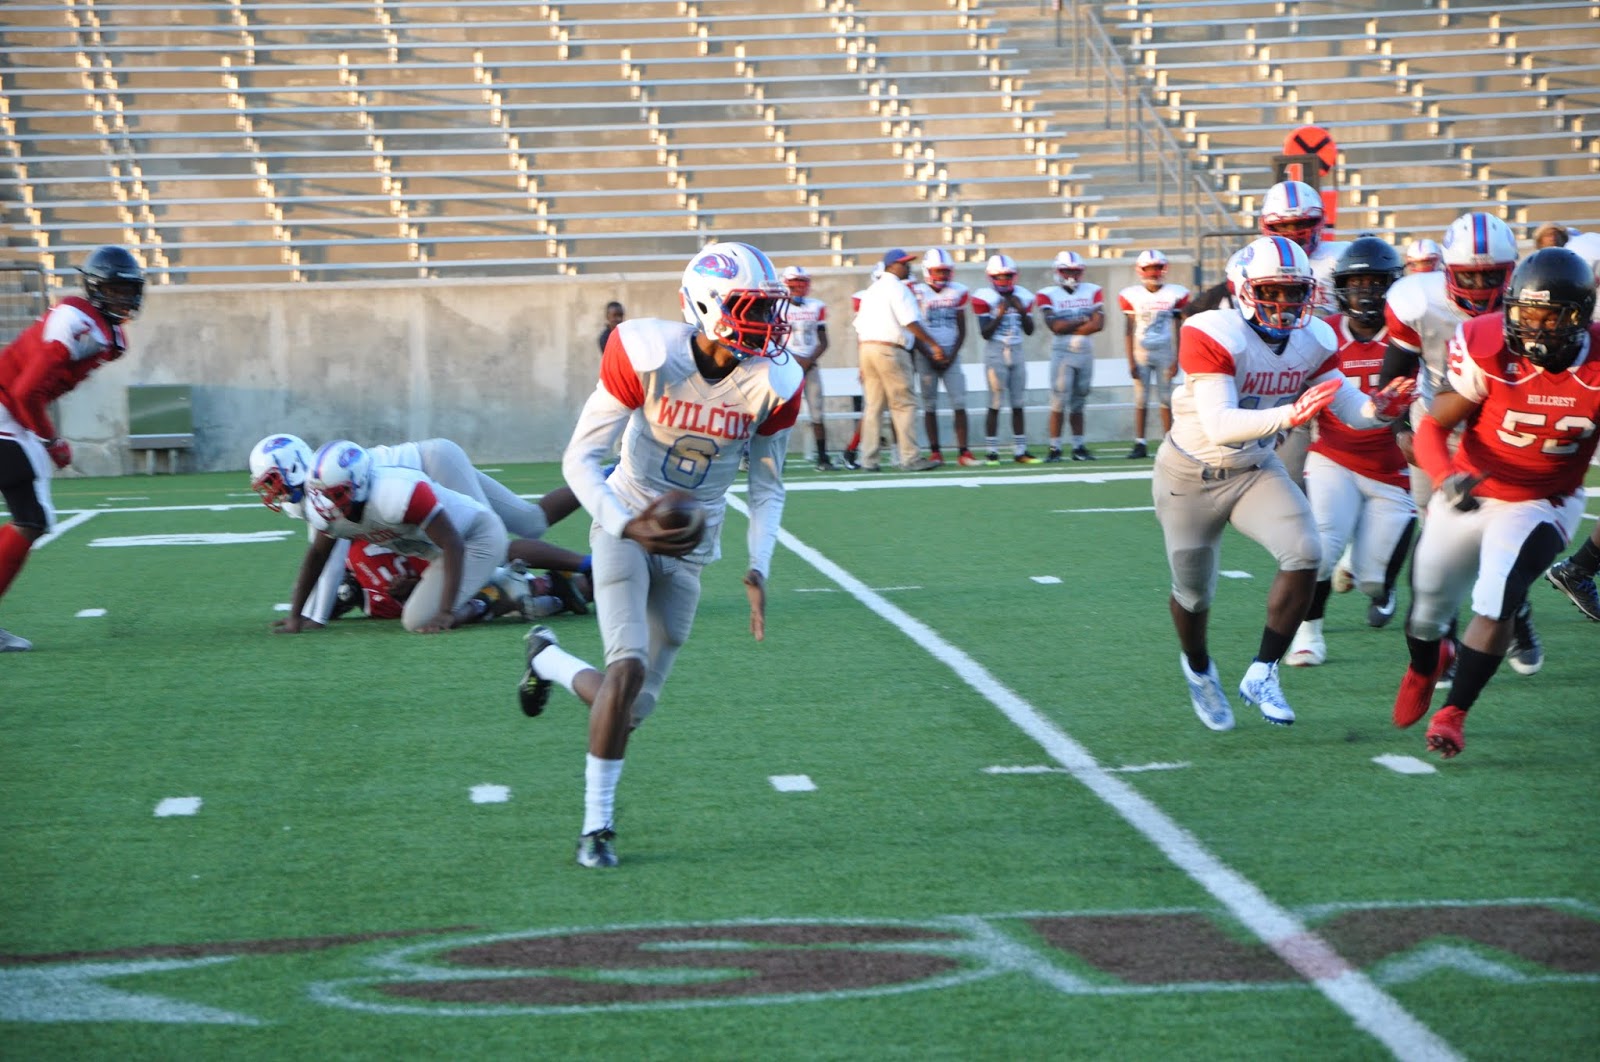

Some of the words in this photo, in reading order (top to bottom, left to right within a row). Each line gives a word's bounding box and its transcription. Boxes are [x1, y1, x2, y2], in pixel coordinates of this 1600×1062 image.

[657, 396, 755, 440] WILCOX
[1527, 394, 1577, 408] HILLCREST
[1496, 408, 1597, 455] 52
[661, 434, 720, 490] 6
